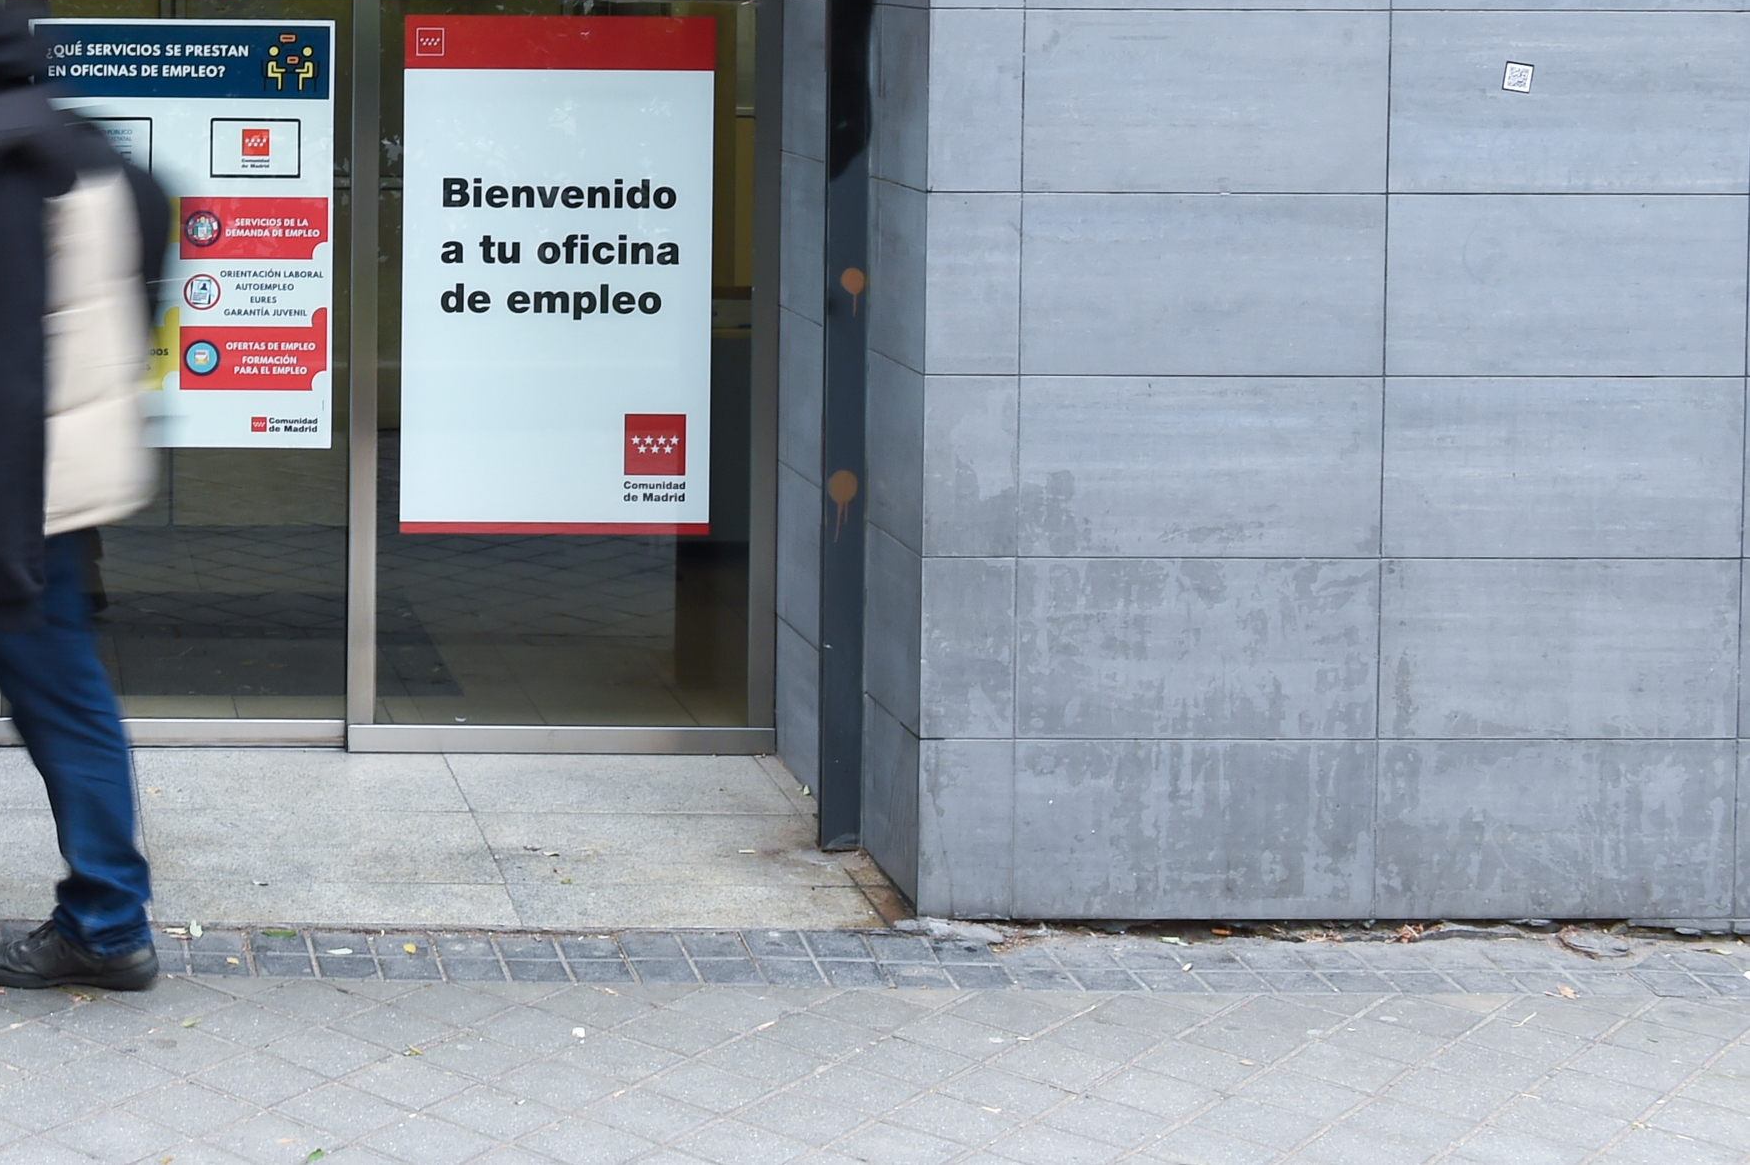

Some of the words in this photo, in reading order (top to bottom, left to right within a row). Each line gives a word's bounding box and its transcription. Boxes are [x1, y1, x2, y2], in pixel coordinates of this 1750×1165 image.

[46, 41, 82, 59] ¿QUÉ
[86, 44, 161, 57] SERVICIOS
[165, 44, 182, 57] SE
[185, 44, 249, 58] PRESTAN
[48, 65, 66, 77] EN
[70, 64, 138, 77] OFICINAS
[141, 65, 158, 77] DE
[162, 65, 226, 78] EMPLEO?
[442, 176, 678, 211] Bienvenido
[235, 218, 282, 227] SERVICIOS
[284, 218, 295, 227] DE
[285, 229, 320, 238] EMPLEO
[440, 240, 464, 265] a
[478, 235, 521, 265] tu
[537, 234, 680, 265] oficina
[220, 268, 281, 278] ORIENTACIÓN
[440, 283, 492, 315] de
[507, 283, 662, 321] empleo
[224, 307, 270, 316] GARANTÍA
[226, 342, 266, 350] OFERTAS
[268, 342, 278, 350] DE
[280, 342, 316, 351] EMPLEO
[242, 354, 296, 364] FORMACIÓN
[623, 480, 686, 490] Comunidad
[623, 493, 638, 502] de
[643, 493, 685, 502] Madrid
